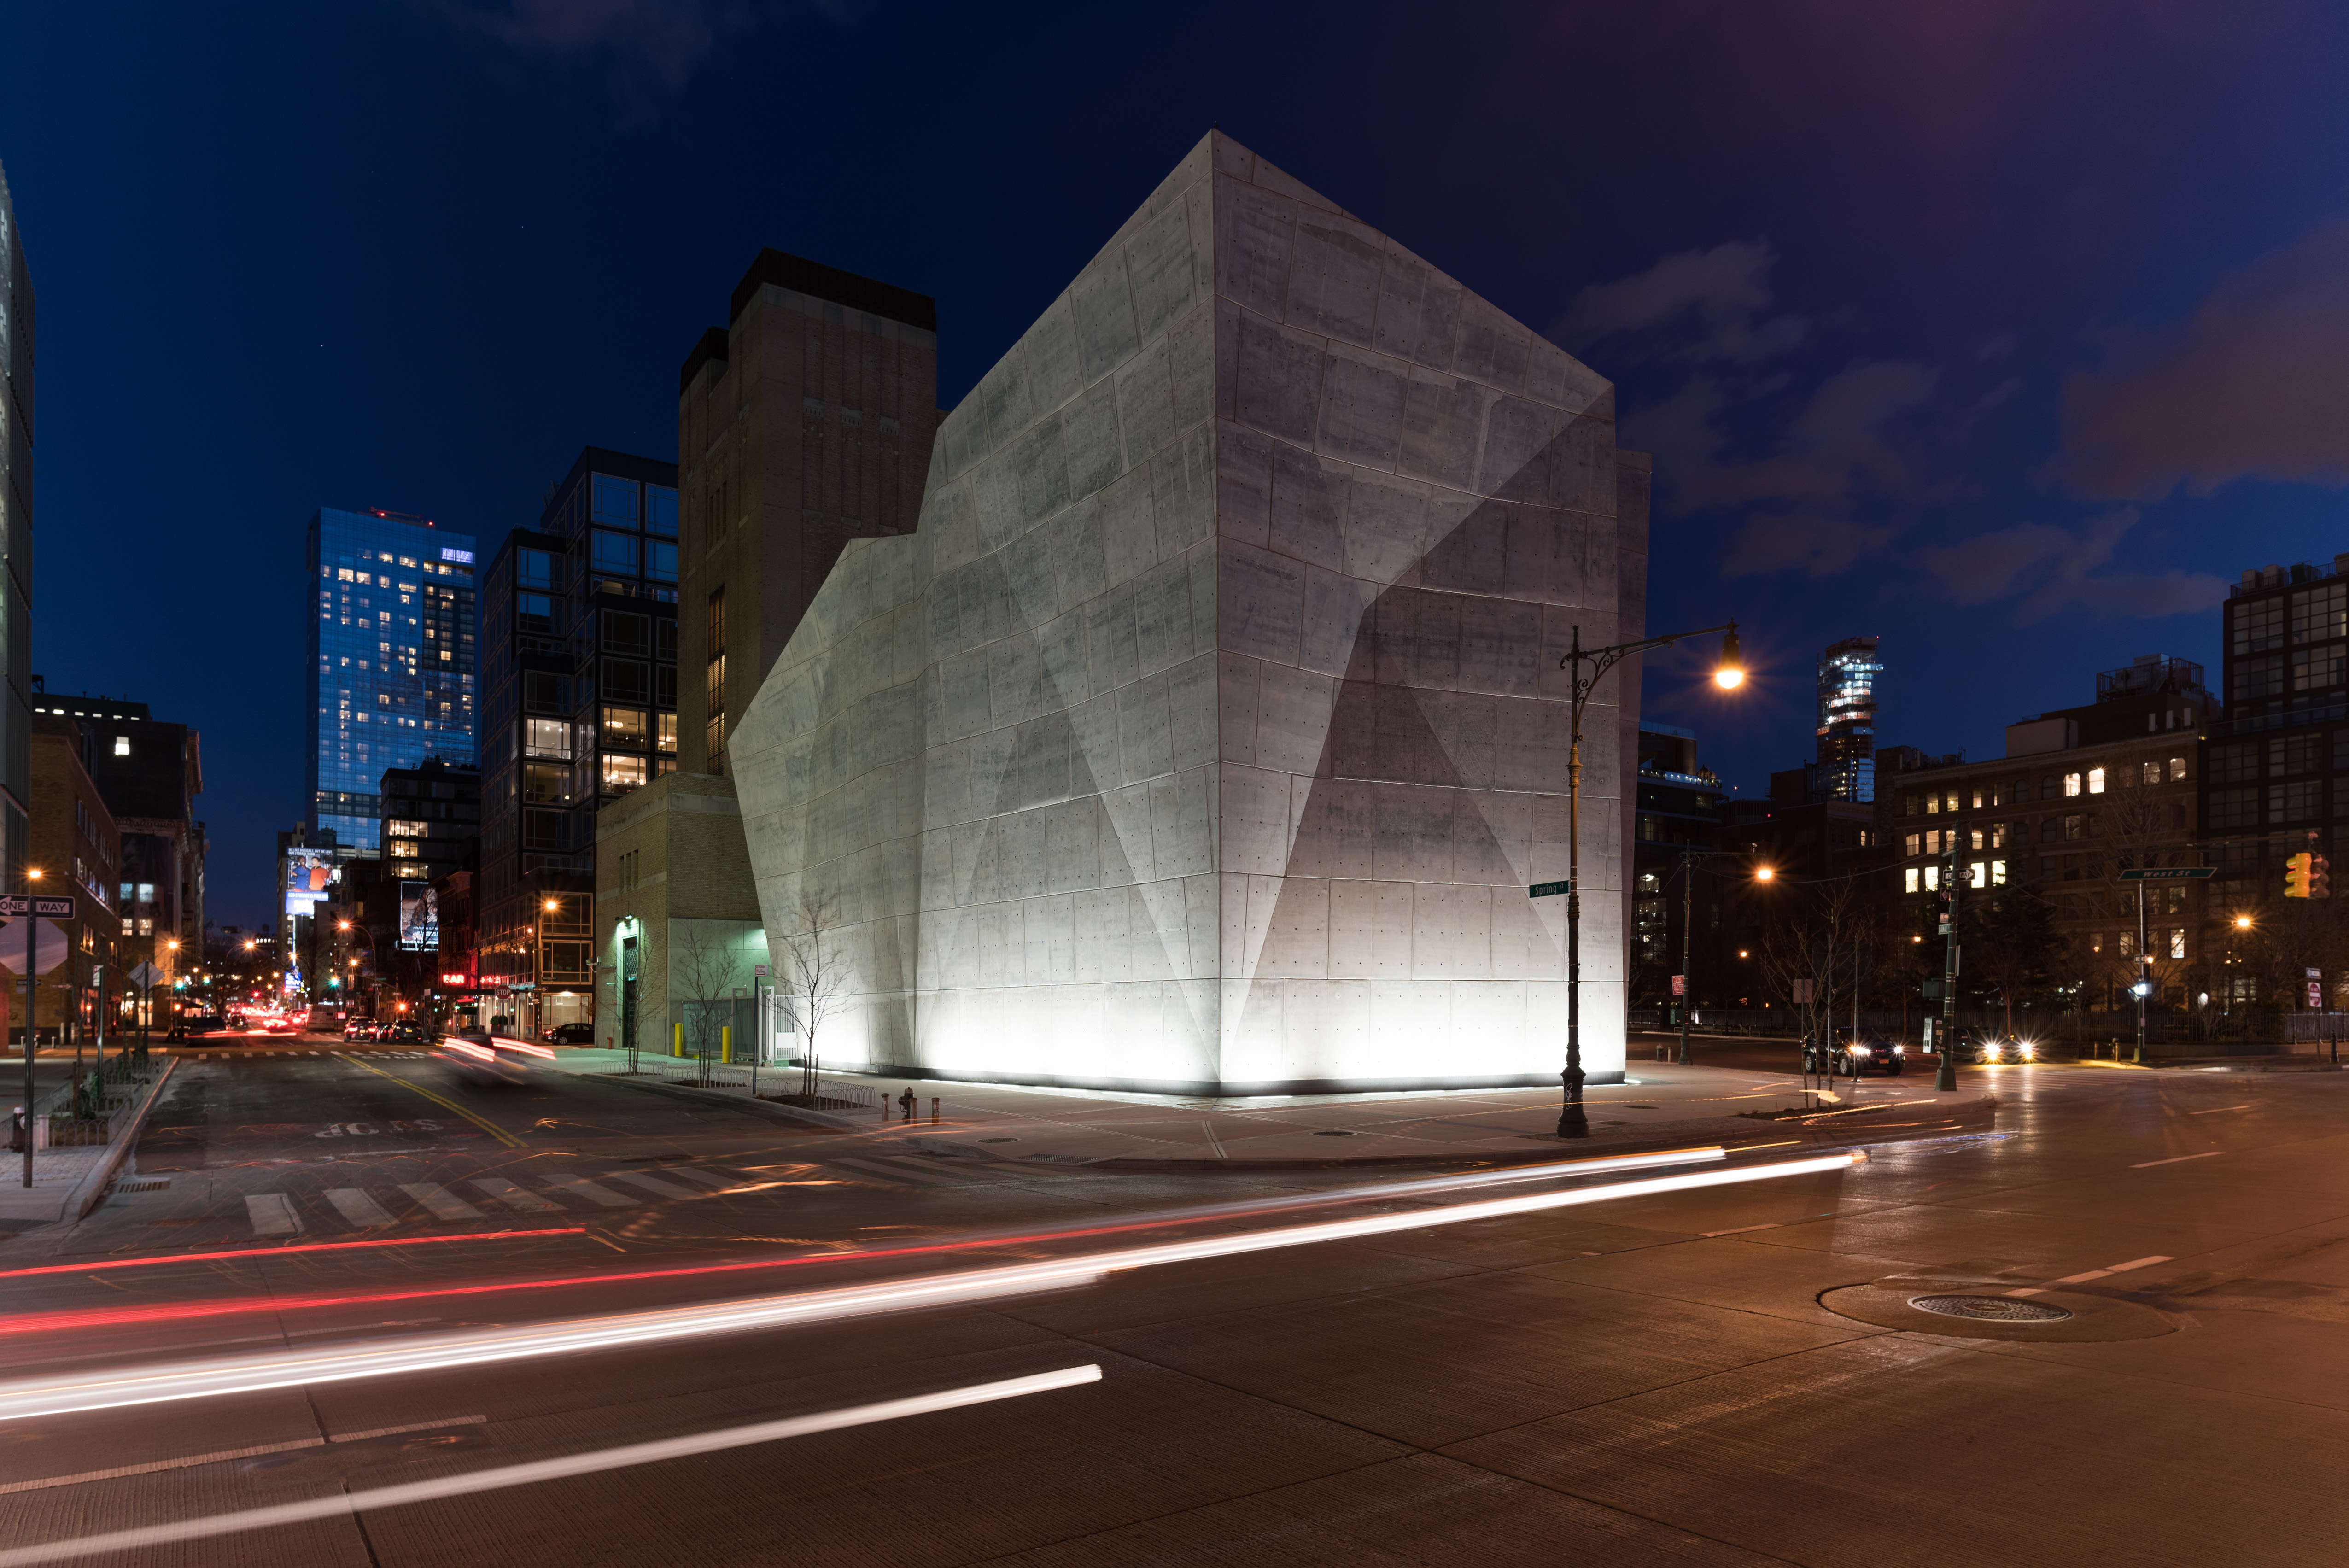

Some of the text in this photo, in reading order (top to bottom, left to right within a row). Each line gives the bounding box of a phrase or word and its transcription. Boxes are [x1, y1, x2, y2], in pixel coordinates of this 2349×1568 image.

[1535, 884, 1556, 896] Spring
[0, 901, 66, 911] ONE WAY
